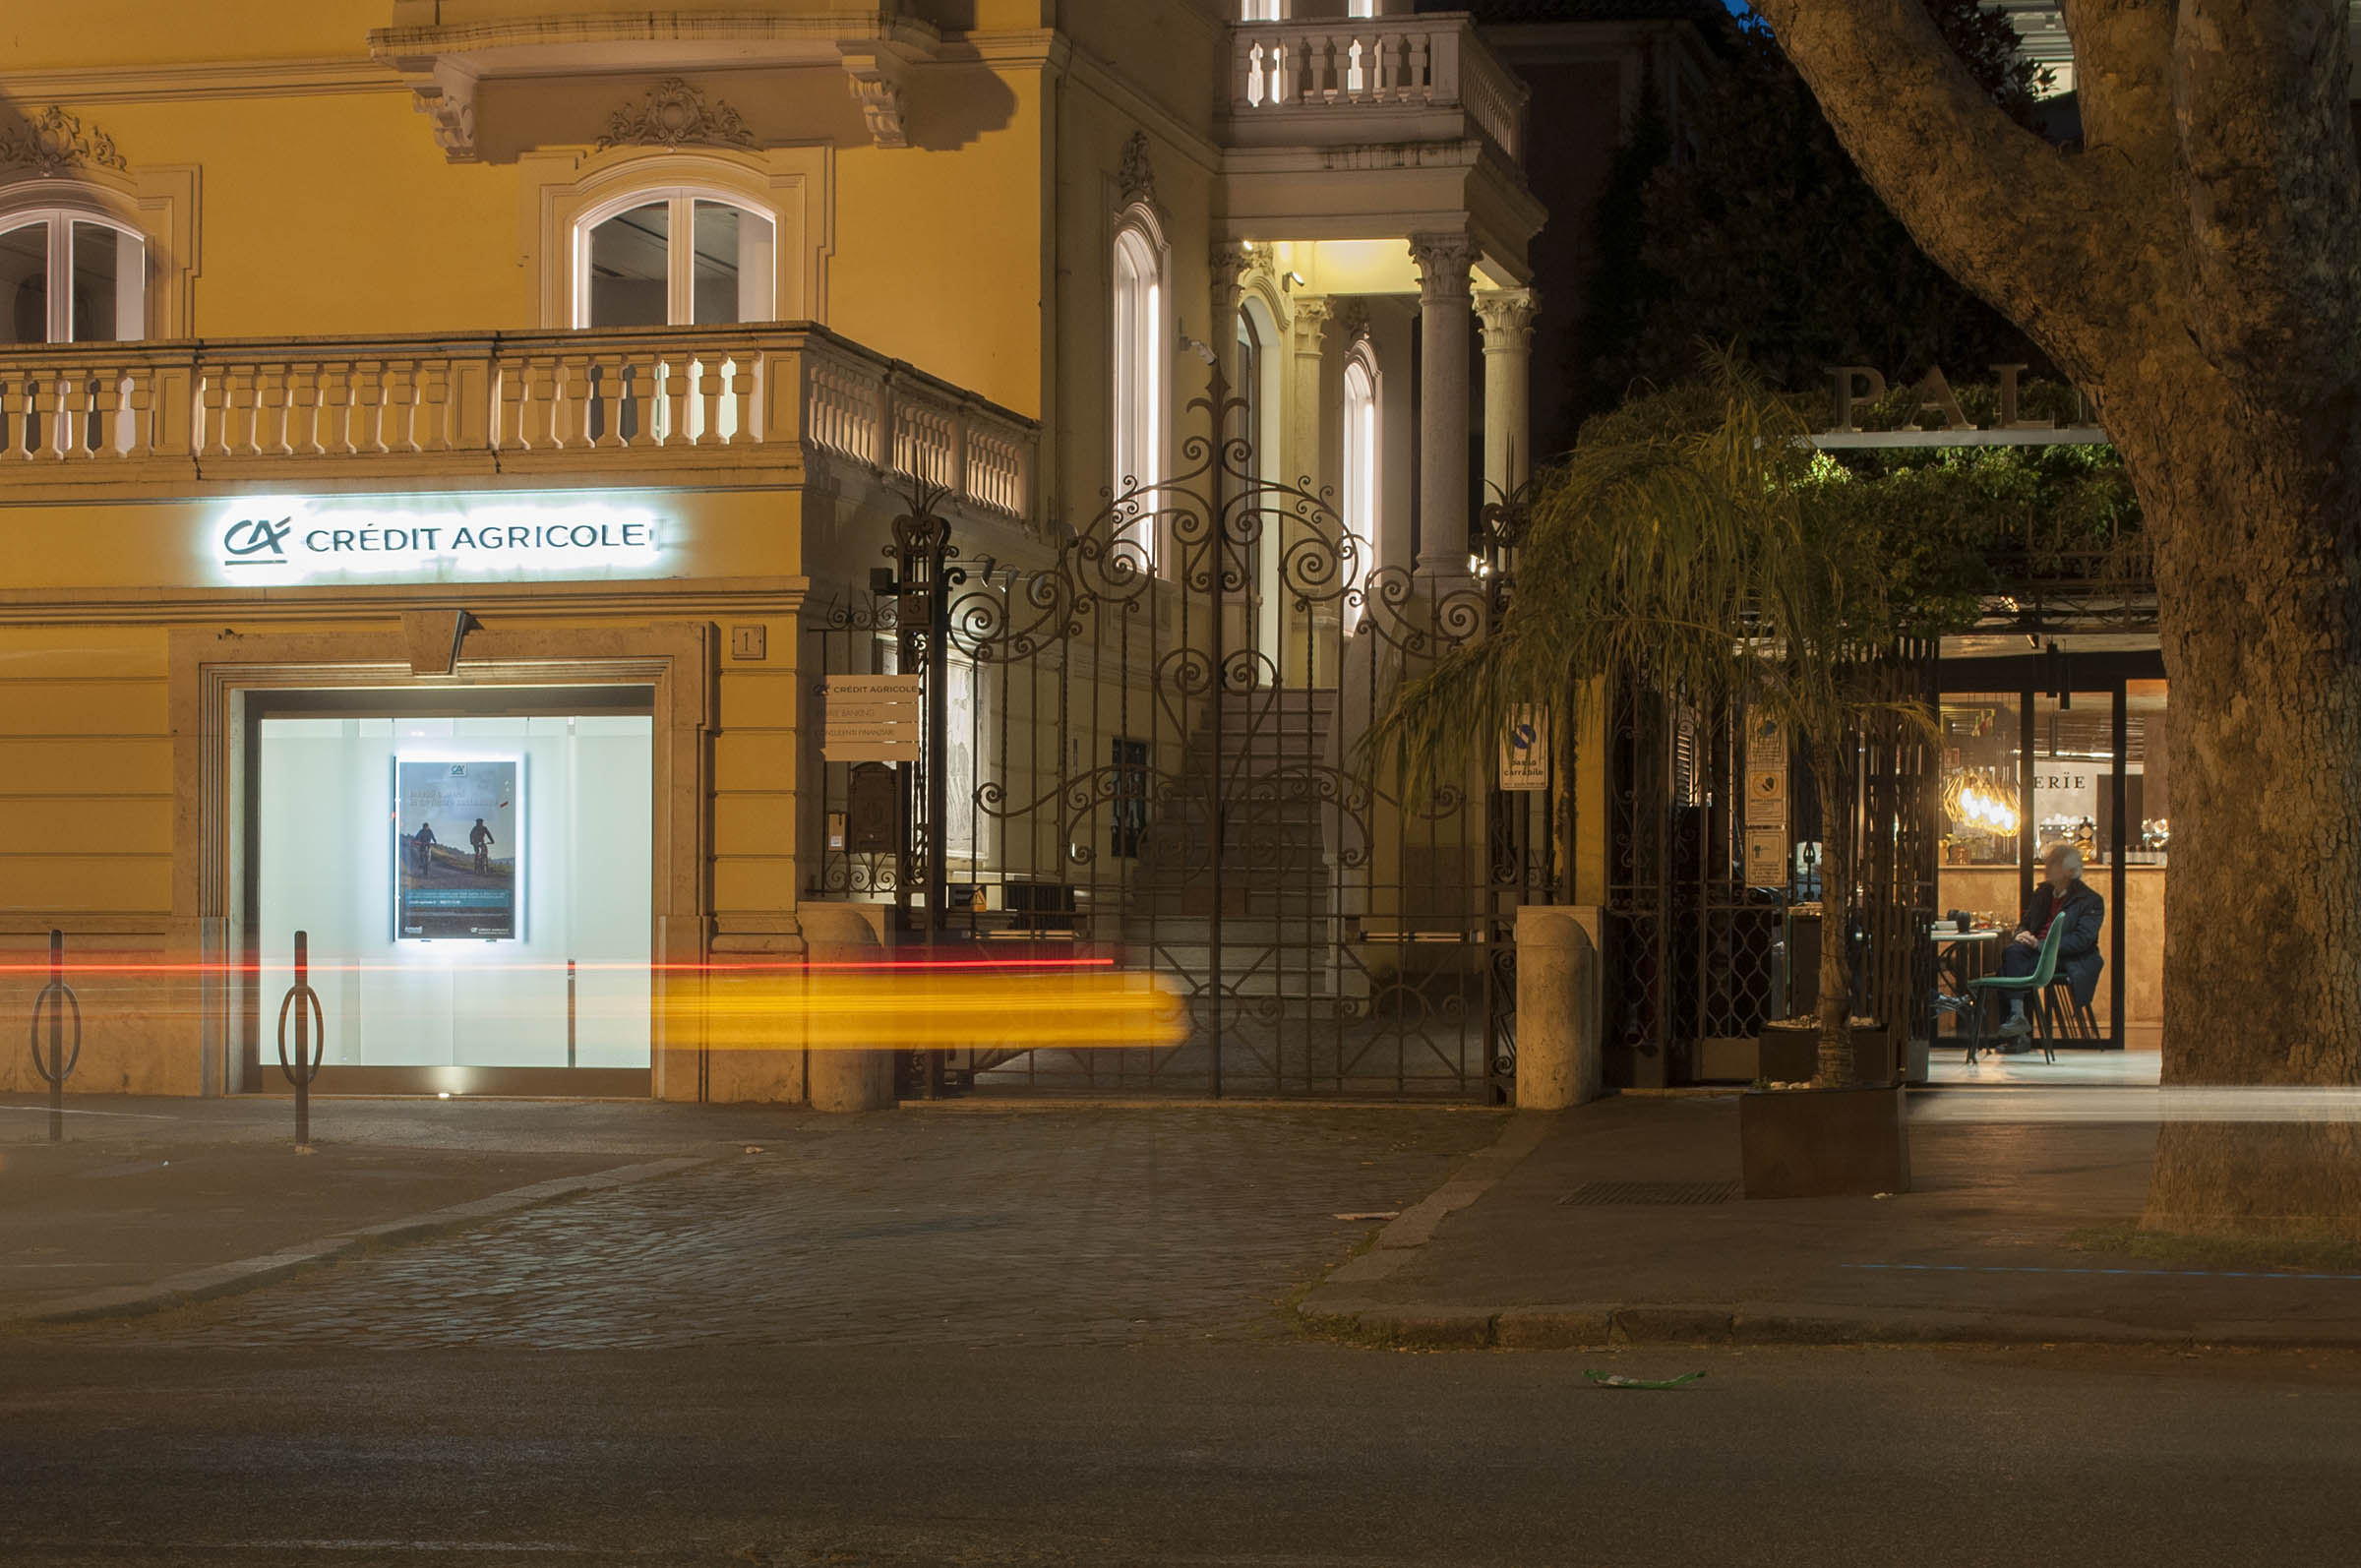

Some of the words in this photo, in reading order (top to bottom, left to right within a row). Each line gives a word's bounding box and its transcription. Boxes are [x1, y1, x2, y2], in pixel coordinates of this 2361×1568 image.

[1823, 363, 2102, 433] PAL
[305, 523, 443, 553] CRÉDIT
[453, 523, 645, 551] AGRICOLE
[833, 685, 868, 694] CRÉDIT
[870, 685, 917, 694] AGRICOLE
